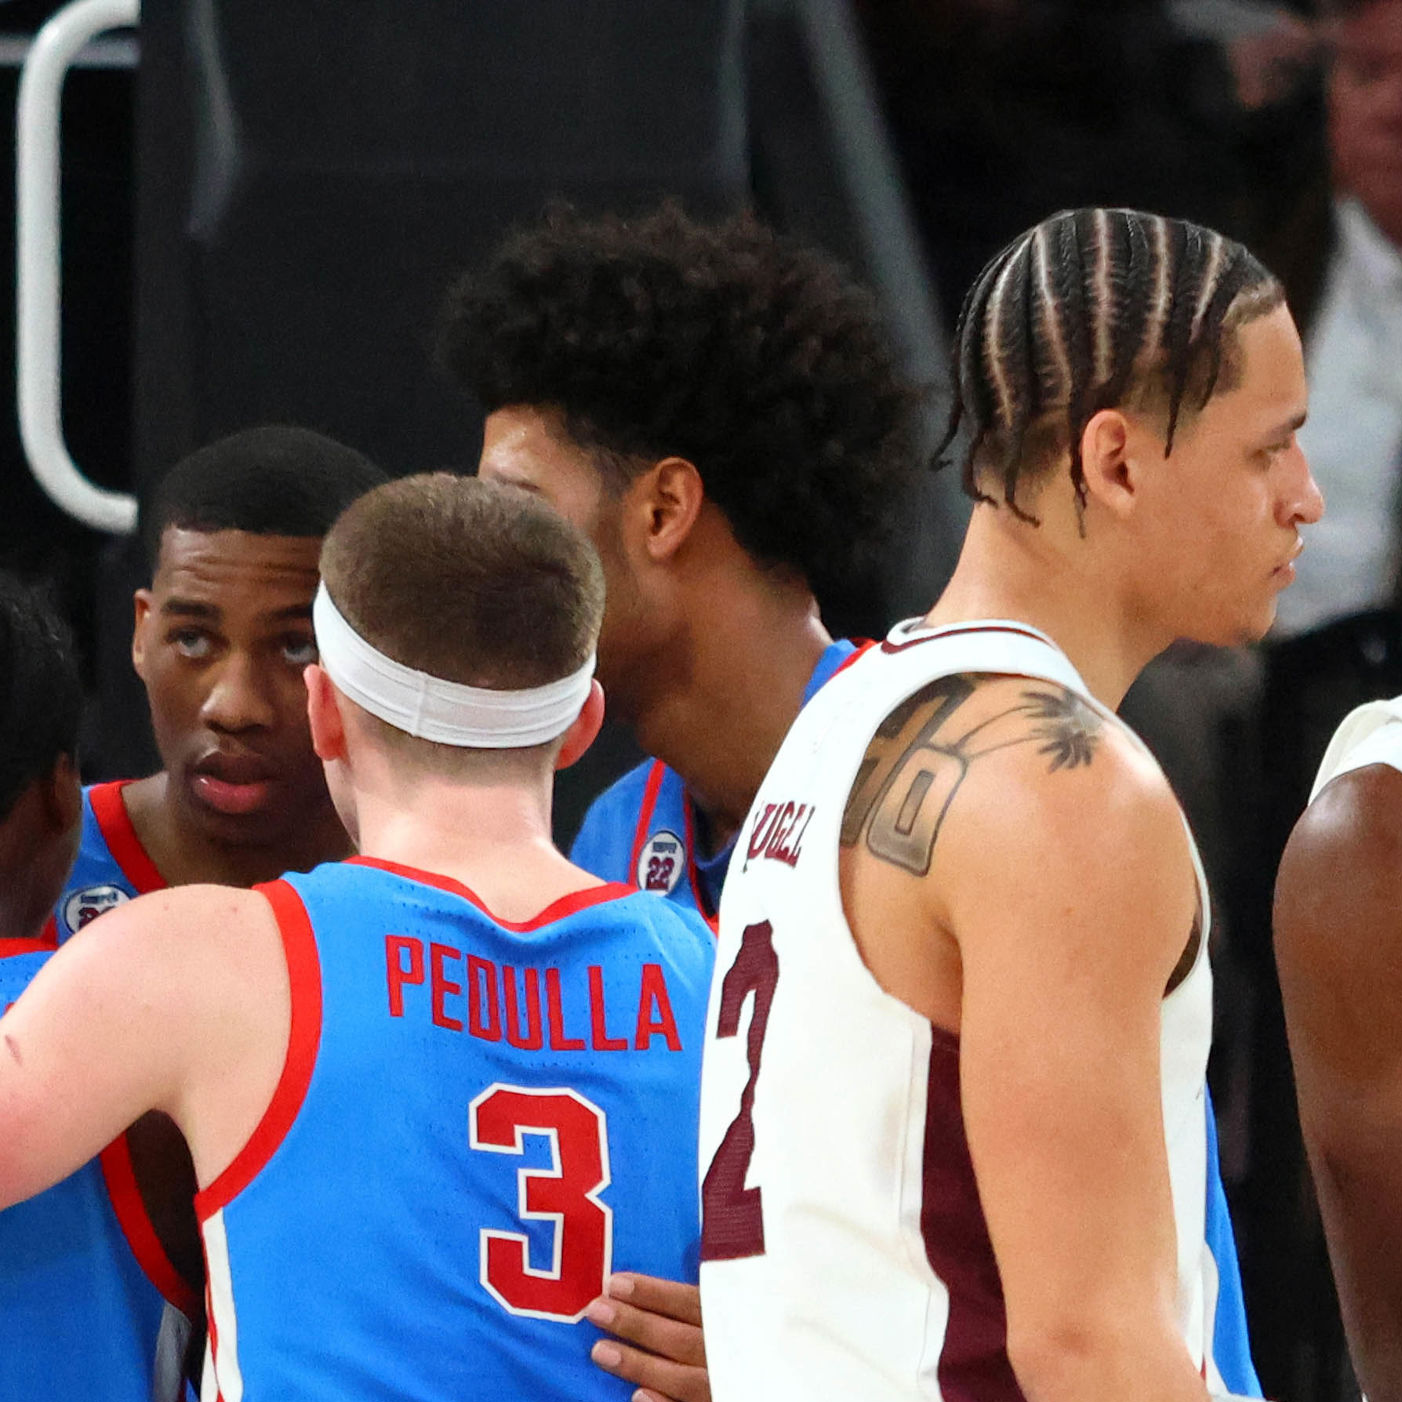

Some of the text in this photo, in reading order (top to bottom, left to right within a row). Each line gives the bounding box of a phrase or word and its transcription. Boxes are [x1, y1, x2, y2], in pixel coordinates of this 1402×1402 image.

[645, 855, 676, 891] 22
[743, 800, 816, 873] UGEL
[385, 933, 684, 1052] PEDULLA
[468, 1082, 613, 1325] 3
